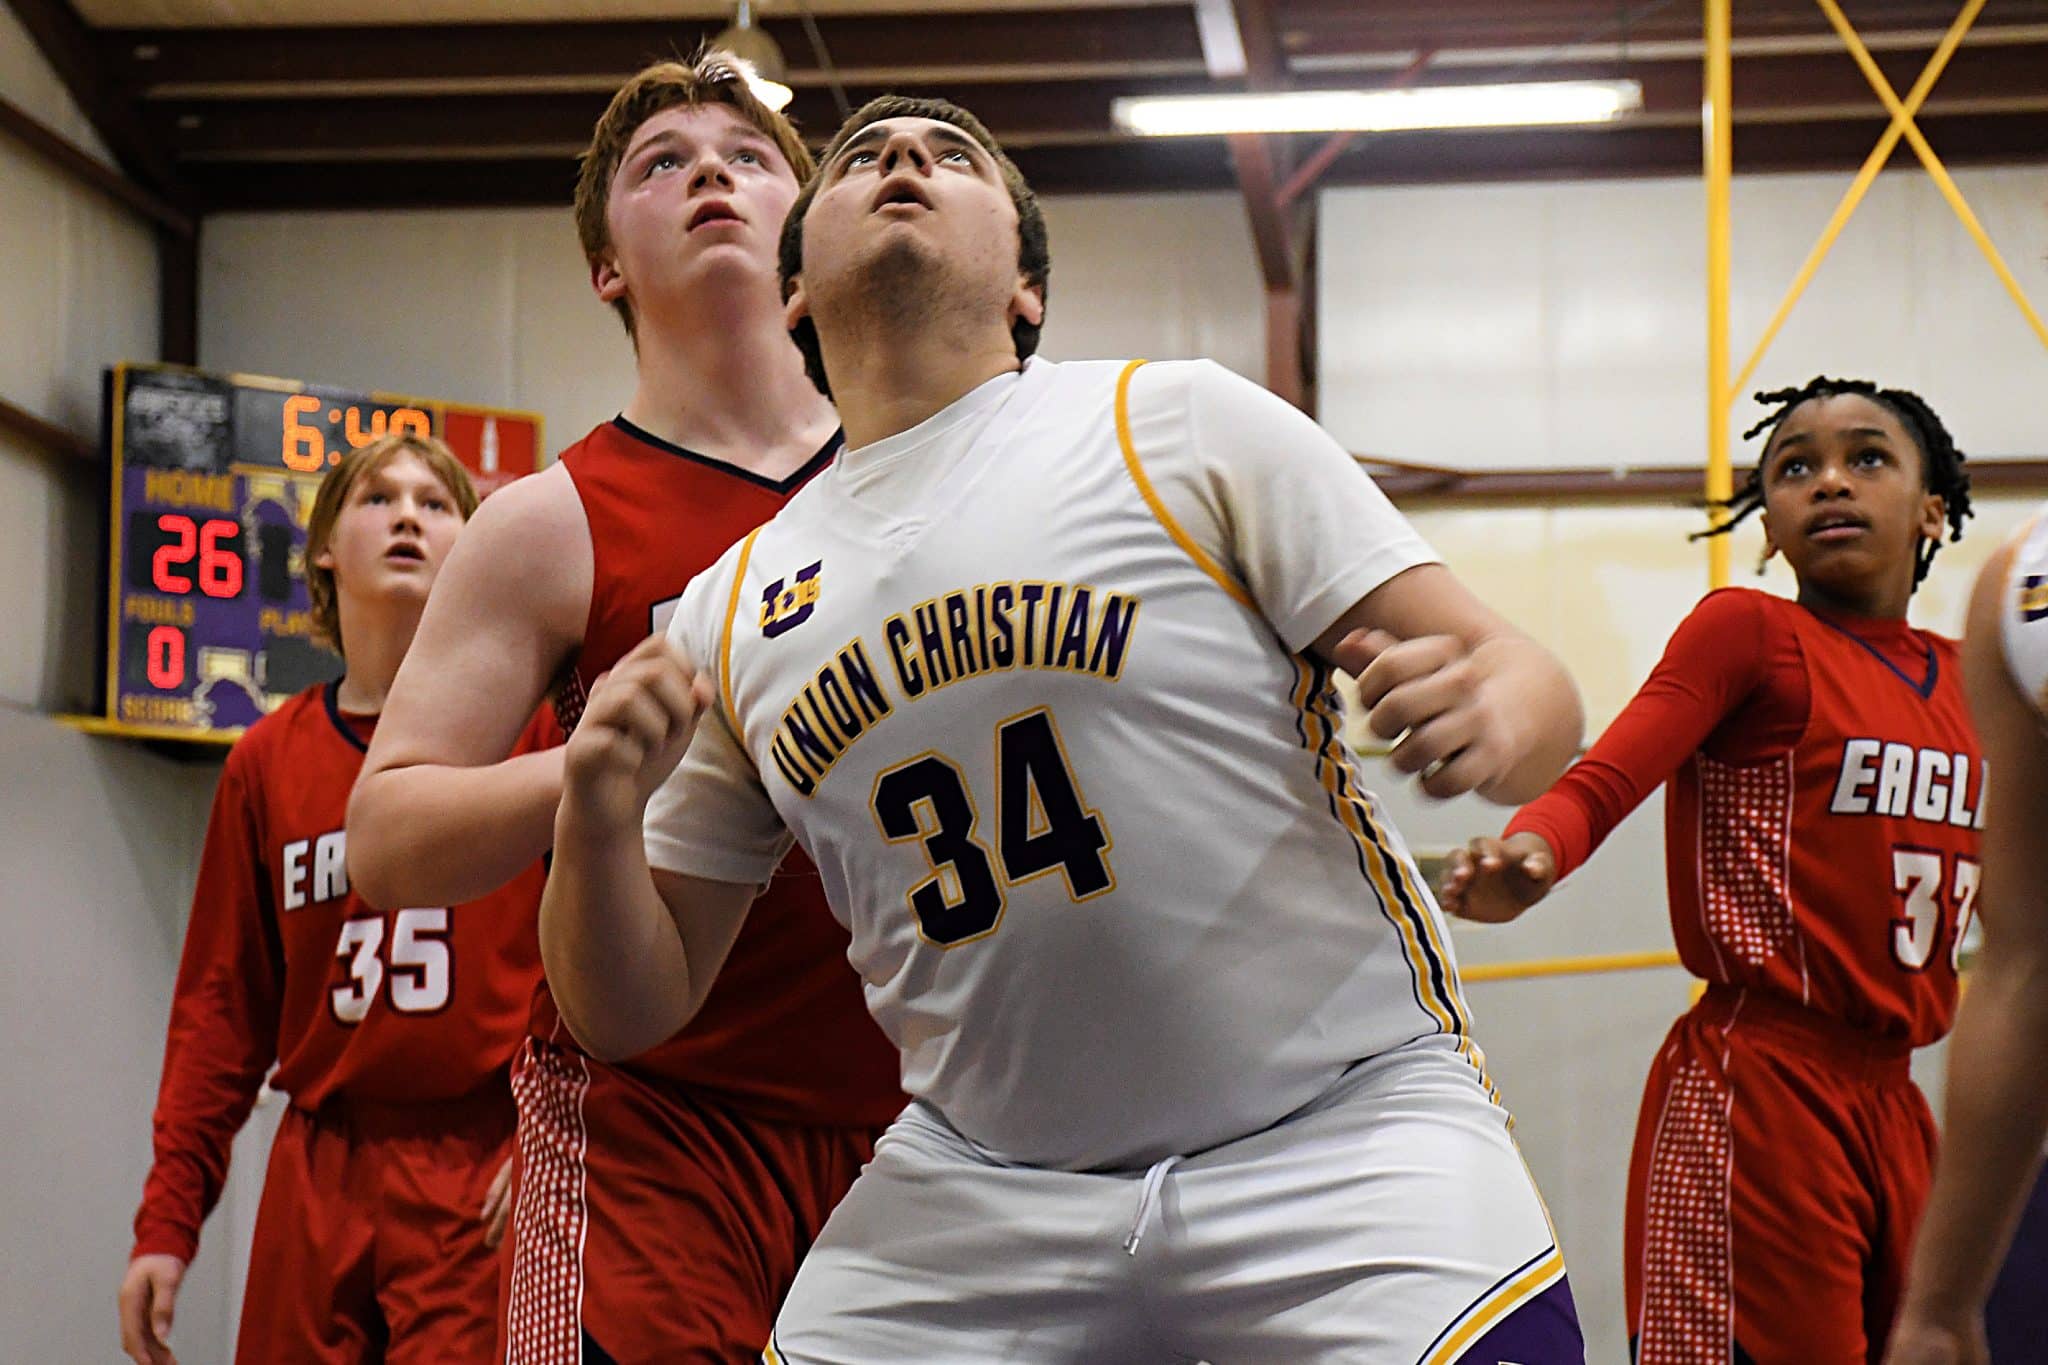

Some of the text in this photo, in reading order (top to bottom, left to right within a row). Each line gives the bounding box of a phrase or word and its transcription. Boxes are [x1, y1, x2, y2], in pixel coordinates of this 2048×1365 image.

[152, 514, 243, 599] 26
[147, 625, 185, 690] 0
[768, 579, 1143, 799] UNION CHRISTIAN
[869, 704, 1118, 951] 34
[331, 905, 451, 1026] 35
